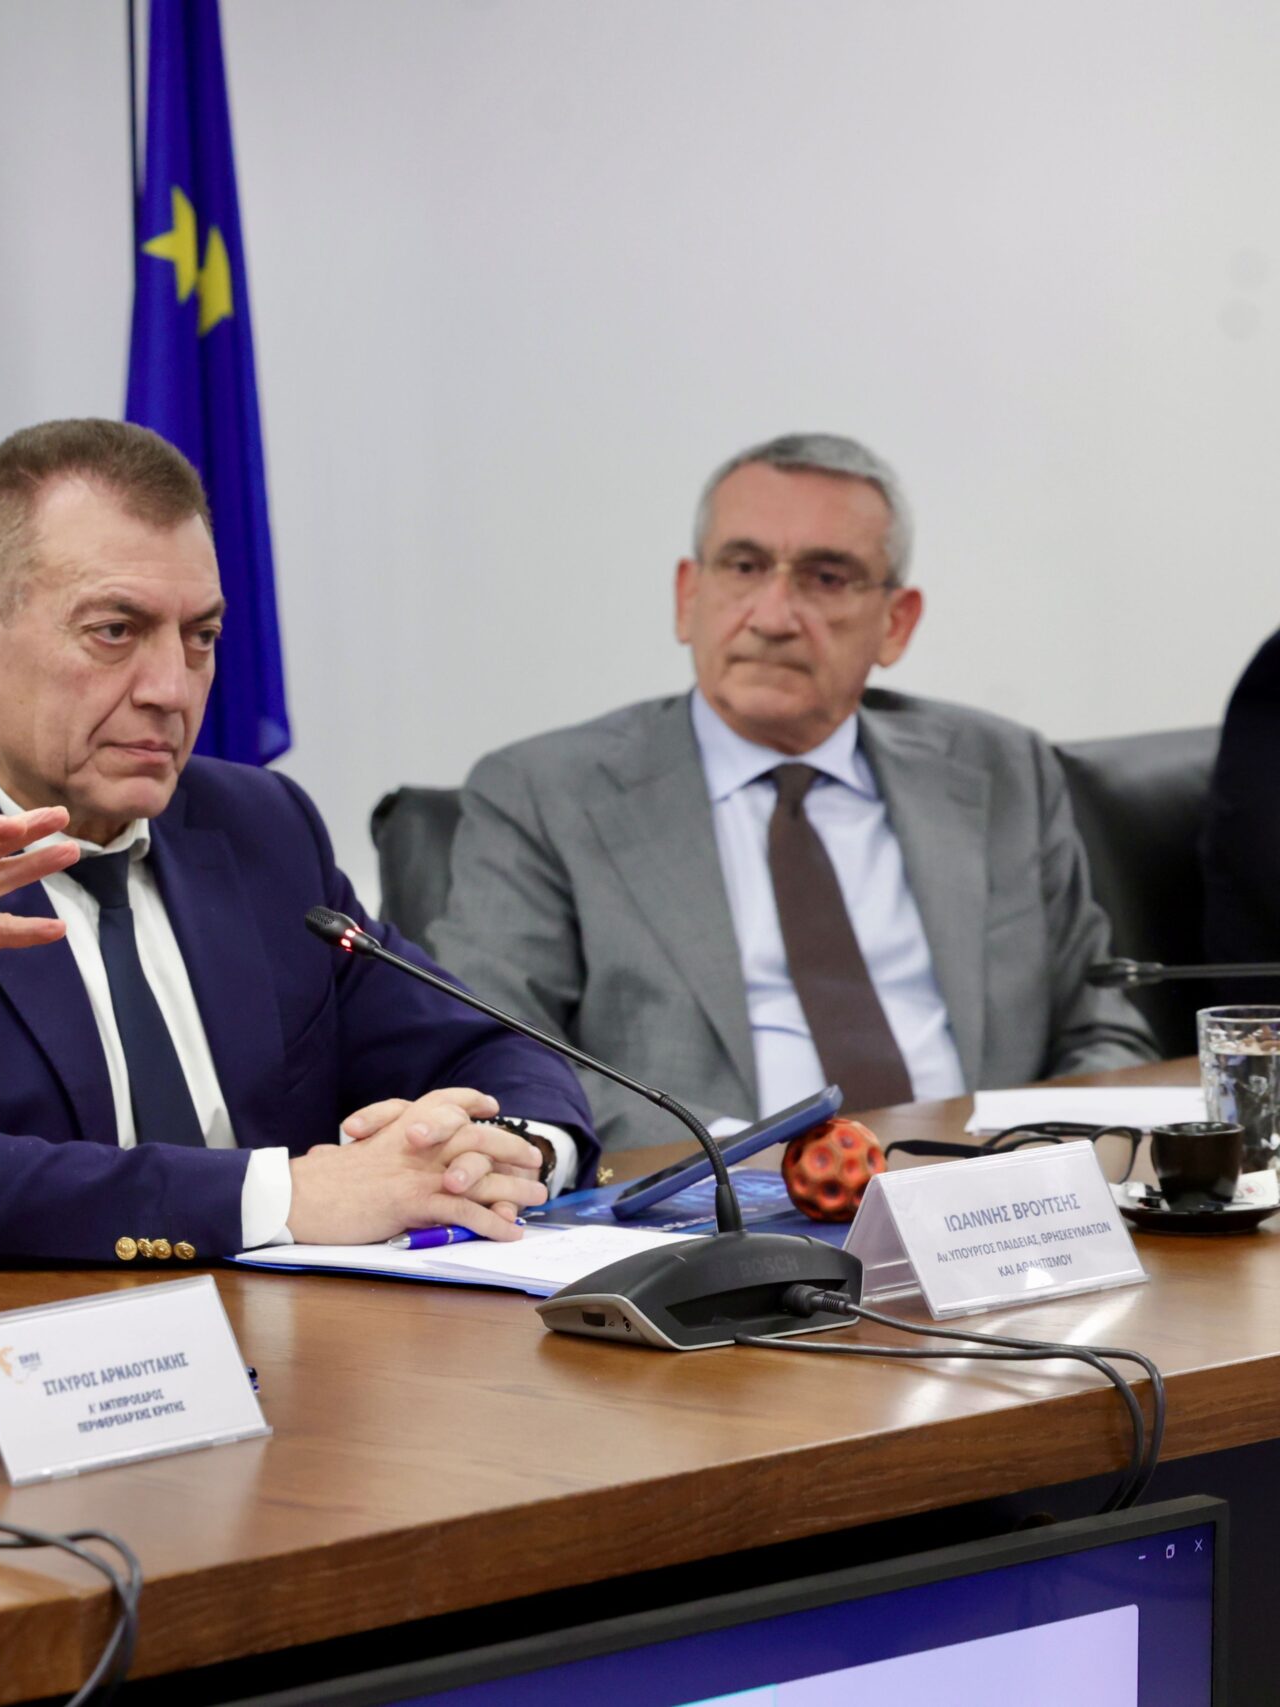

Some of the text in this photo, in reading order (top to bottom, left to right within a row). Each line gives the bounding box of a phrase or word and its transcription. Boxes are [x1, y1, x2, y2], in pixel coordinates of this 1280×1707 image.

[944, 1193, 1081, 1232] ΙΩΑΝΝΗΣ ΒΡΟΥΤΣΗΣ
[996, 1234, 1042, 1252] ΠΑΙΔΕΙΑΣ,
[1041, 1221, 1112, 1244] ΘΡΗΣΚΕΥΜΑΤΩΝ
[738, 1253, 800, 1278] BOSCH
[998, 1264, 1015, 1277] ΚΑΙ
[42, 1352, 189, 1396] ΣΤΑΥΡΟΣ ΑΡΝΑΟΥΤΑΚΗΣ
[99, 1388, 164, 1412] ΑΝΤΙΠΡΟΕΔΡΟΣ
[77, 1400, 186, 1433] ΠΕΡΙΦΕΡΕΙΑΡΧΗΣ ΚΡΗΤΗΣ
